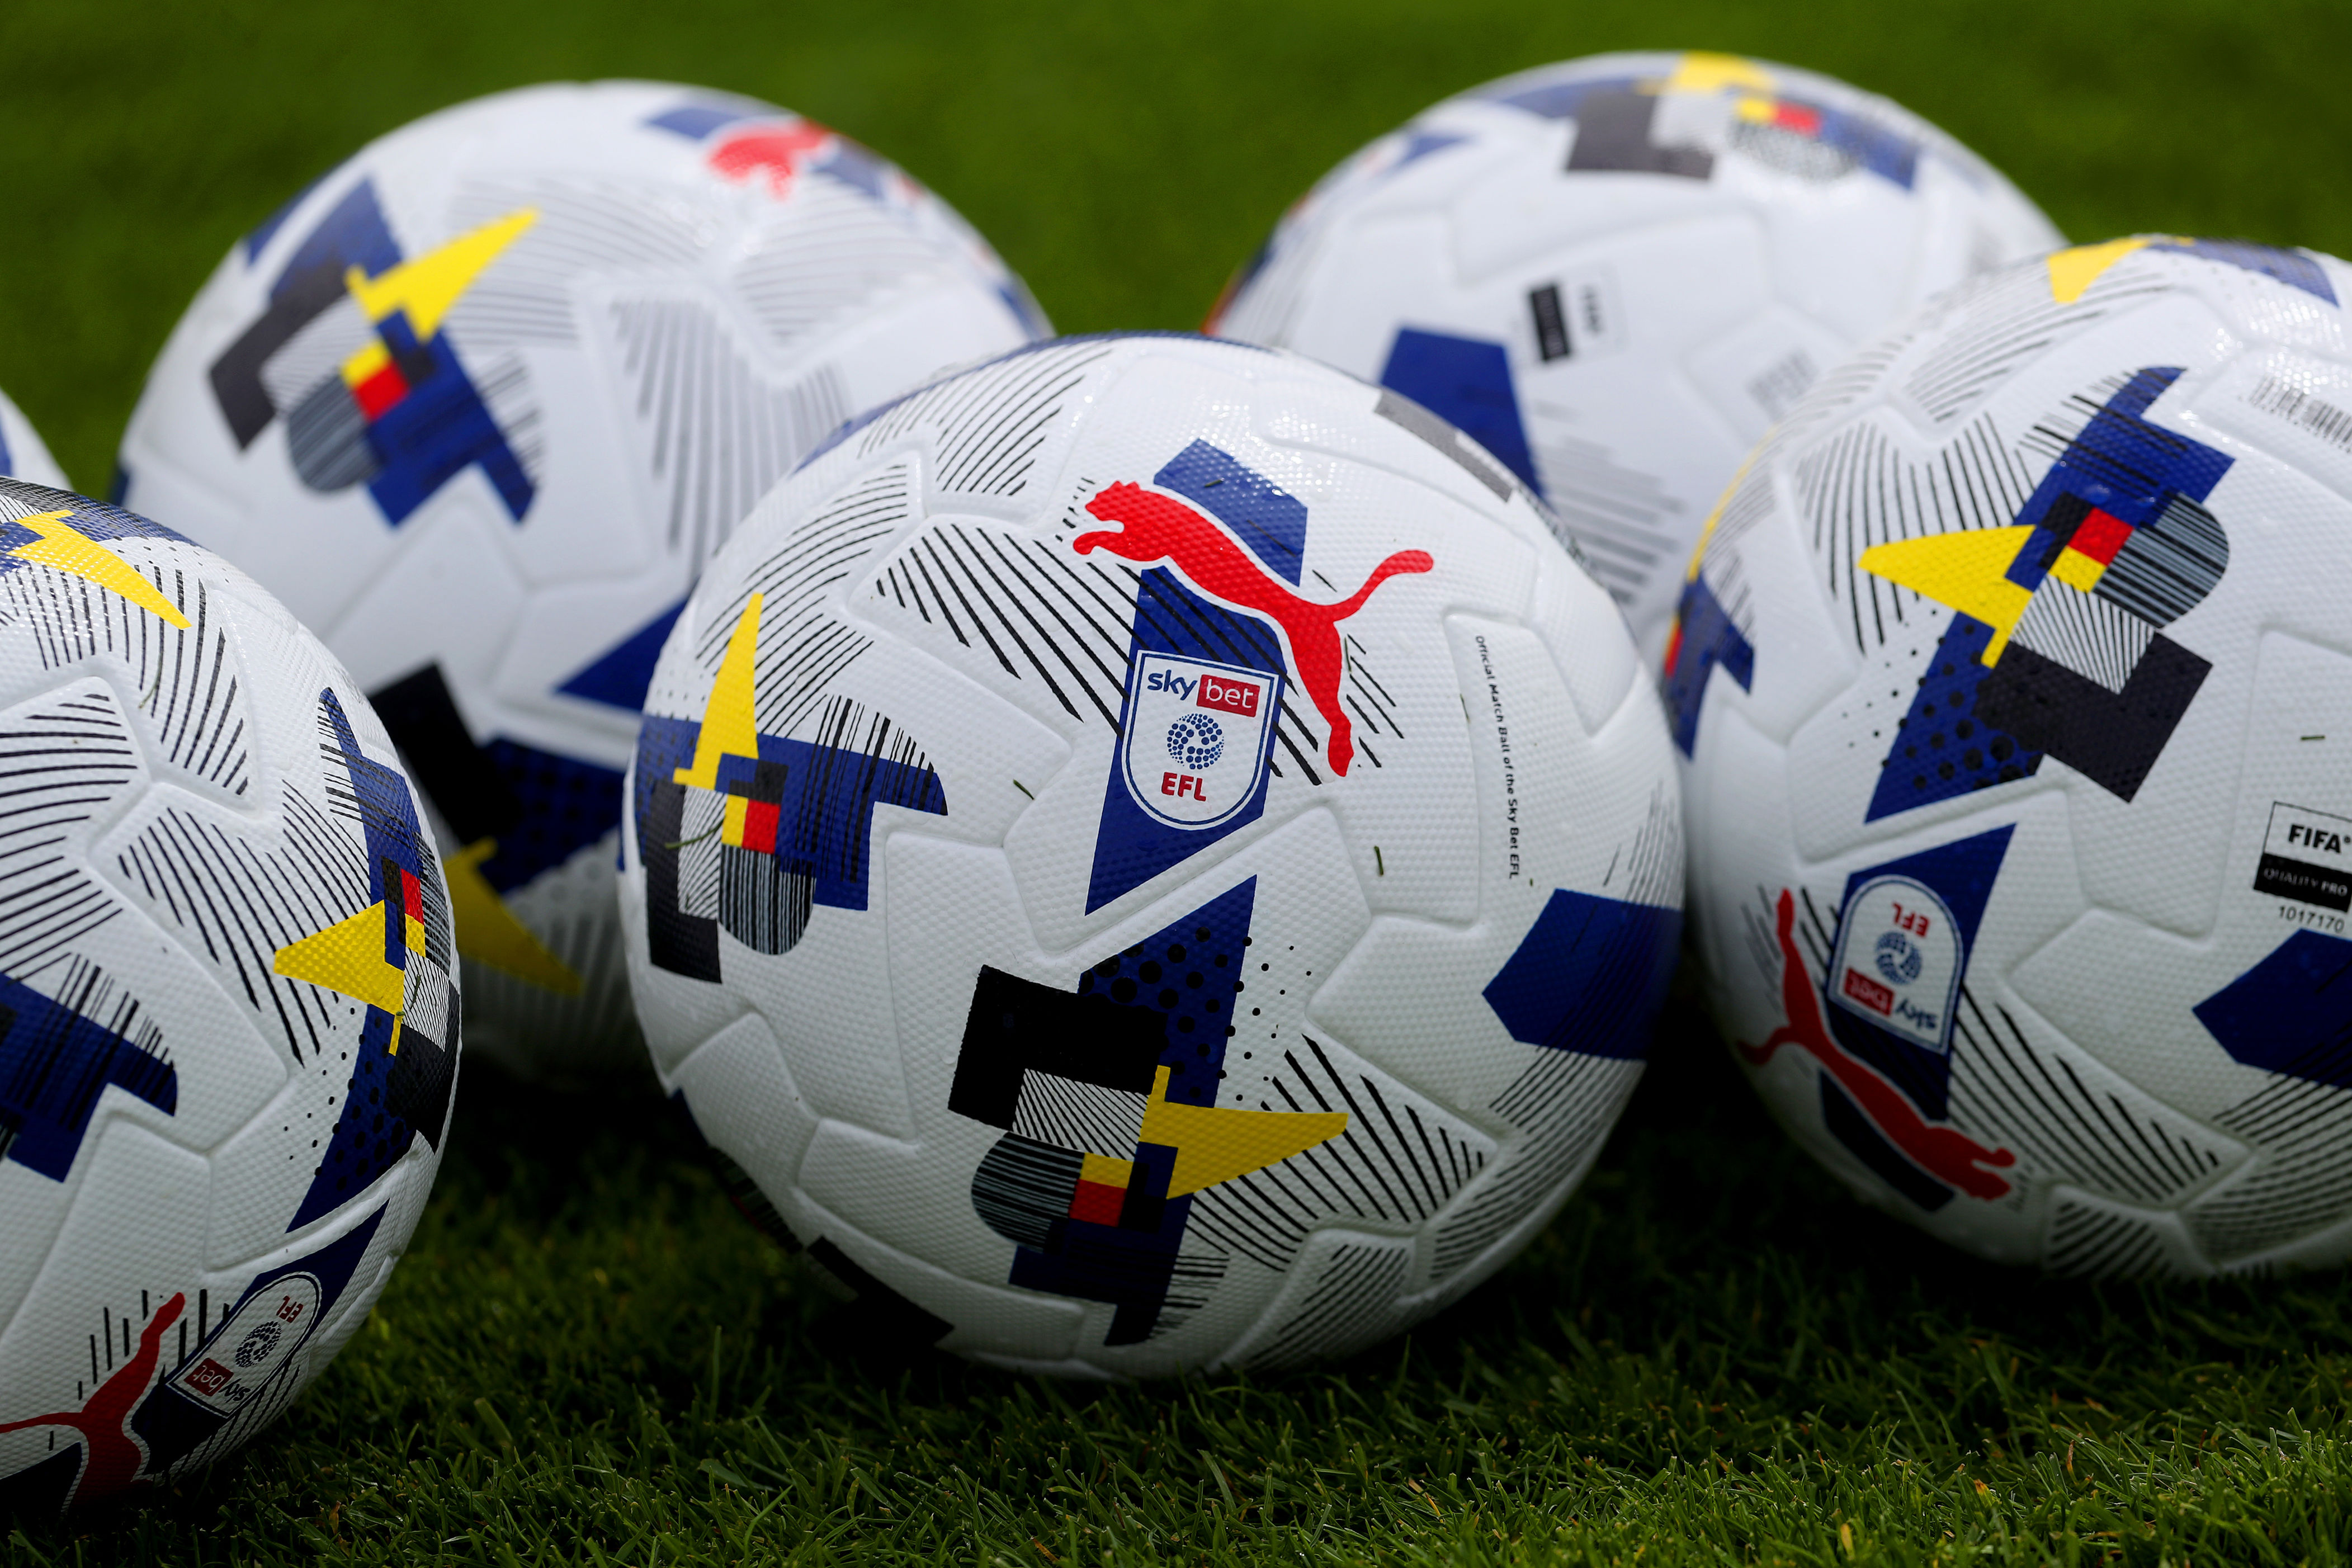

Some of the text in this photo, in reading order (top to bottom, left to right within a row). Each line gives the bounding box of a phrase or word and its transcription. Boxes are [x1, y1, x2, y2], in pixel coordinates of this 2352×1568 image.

[1147, 669, 1254, 709] sky bet
[1475, 635, 1519, 879] Official Match Ball of the Sky Bet EFL
[1161, 771, 1207, 802] EFL
[2321, 880, 2348, 897] PRO
[1892, 901, 1931, 938] EFL
[2278, 905, 2345, 934] 1017170
[276, 1295, 304, 1323] EFL
[192, 1364, 251, 1403] sky bet
